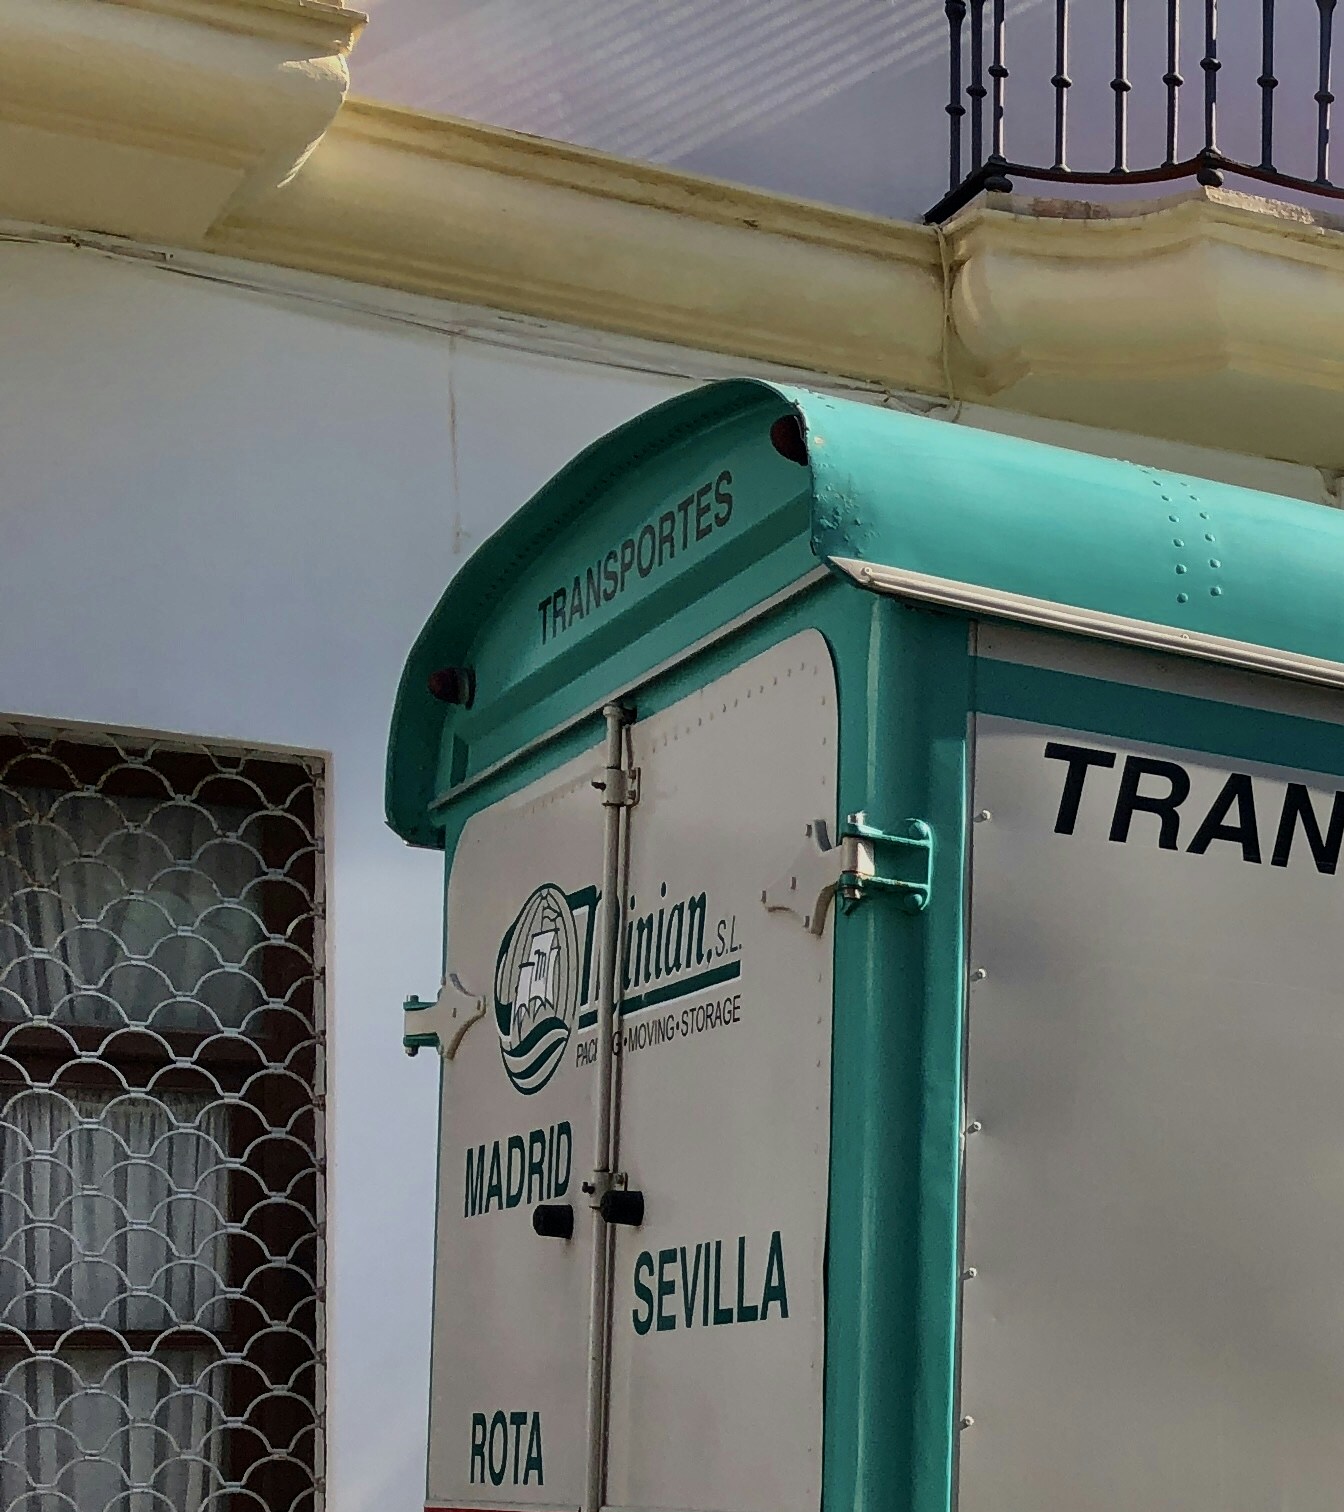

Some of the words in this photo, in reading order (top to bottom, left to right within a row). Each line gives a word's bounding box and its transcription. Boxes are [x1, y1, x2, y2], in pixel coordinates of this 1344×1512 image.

[537, 470, 734, 645] TRANSPORTES
[715, 914, 742, 958] S.L.
[464, 1120, 572, 1218] MADRID
[632, 1231, 789, 1335] SEVILLA
[470, 1411, 544, 1487] ROTA
